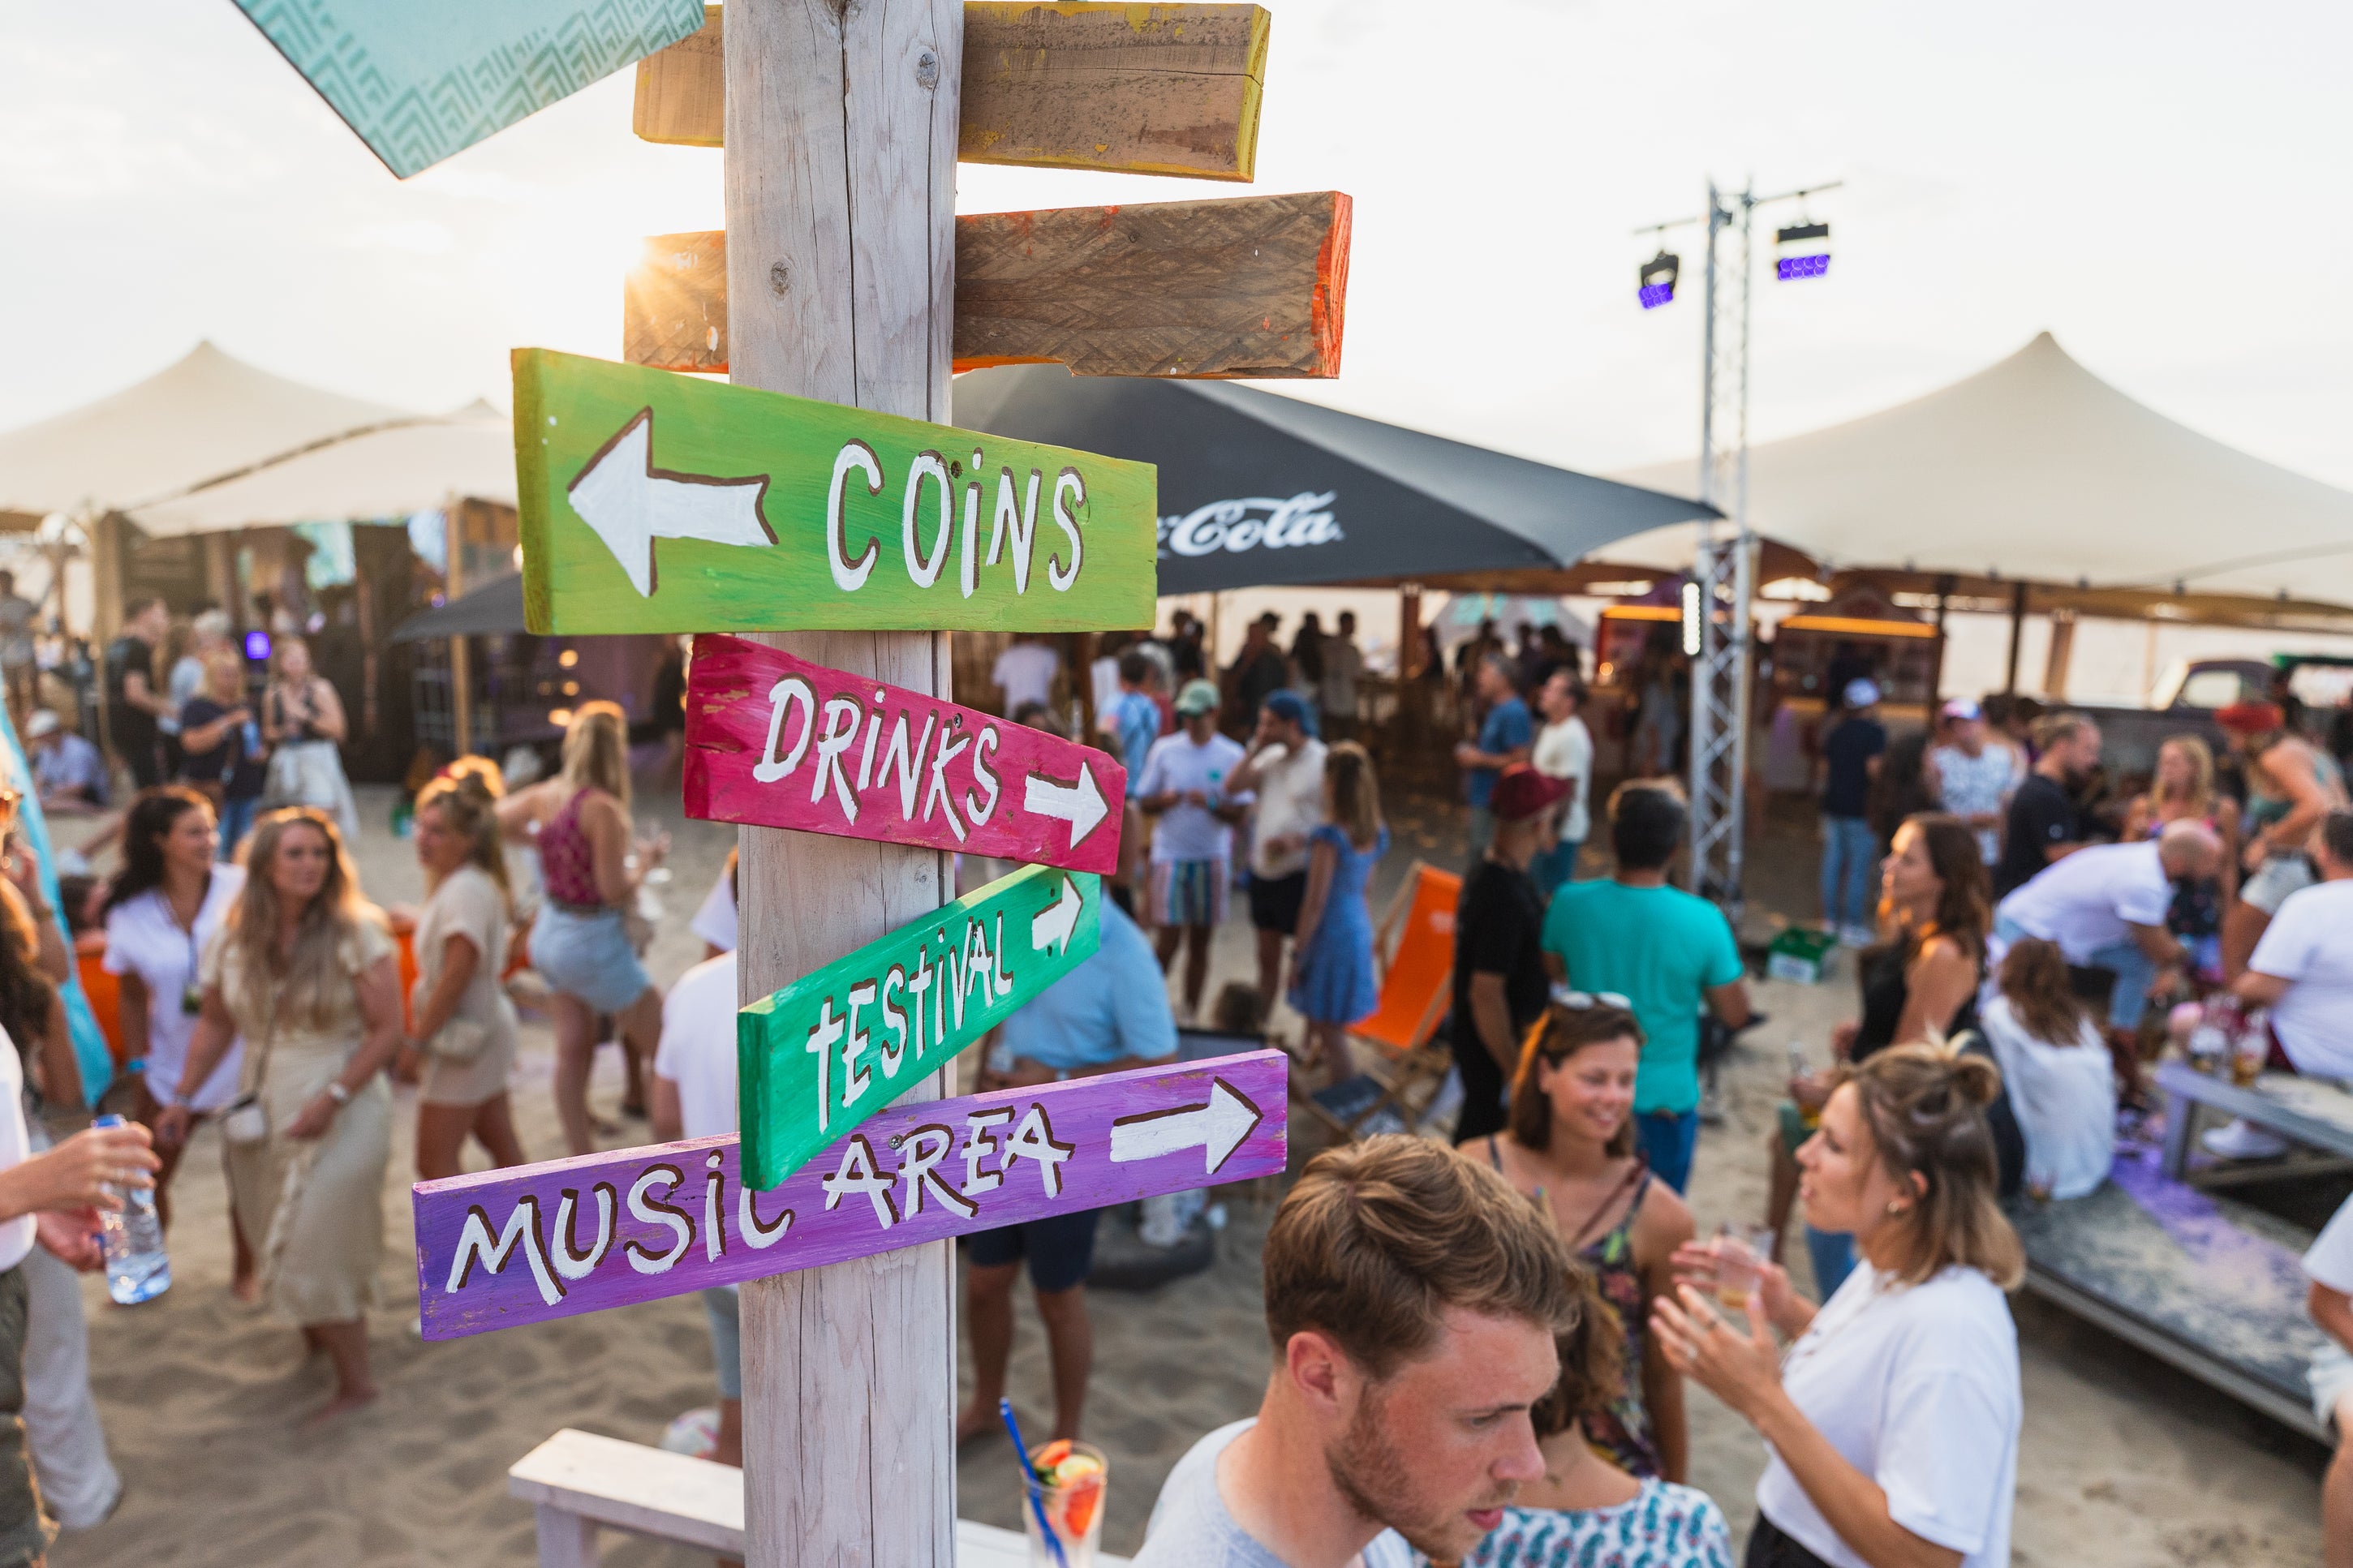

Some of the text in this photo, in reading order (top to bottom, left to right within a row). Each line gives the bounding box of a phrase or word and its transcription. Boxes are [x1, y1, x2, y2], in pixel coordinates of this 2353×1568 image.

[826, 438, 1086, 599] COiNS
[753, 673, 1000, 844] DRiNKS
[445, 1102, 1076, 1305] MUSiC AREA
